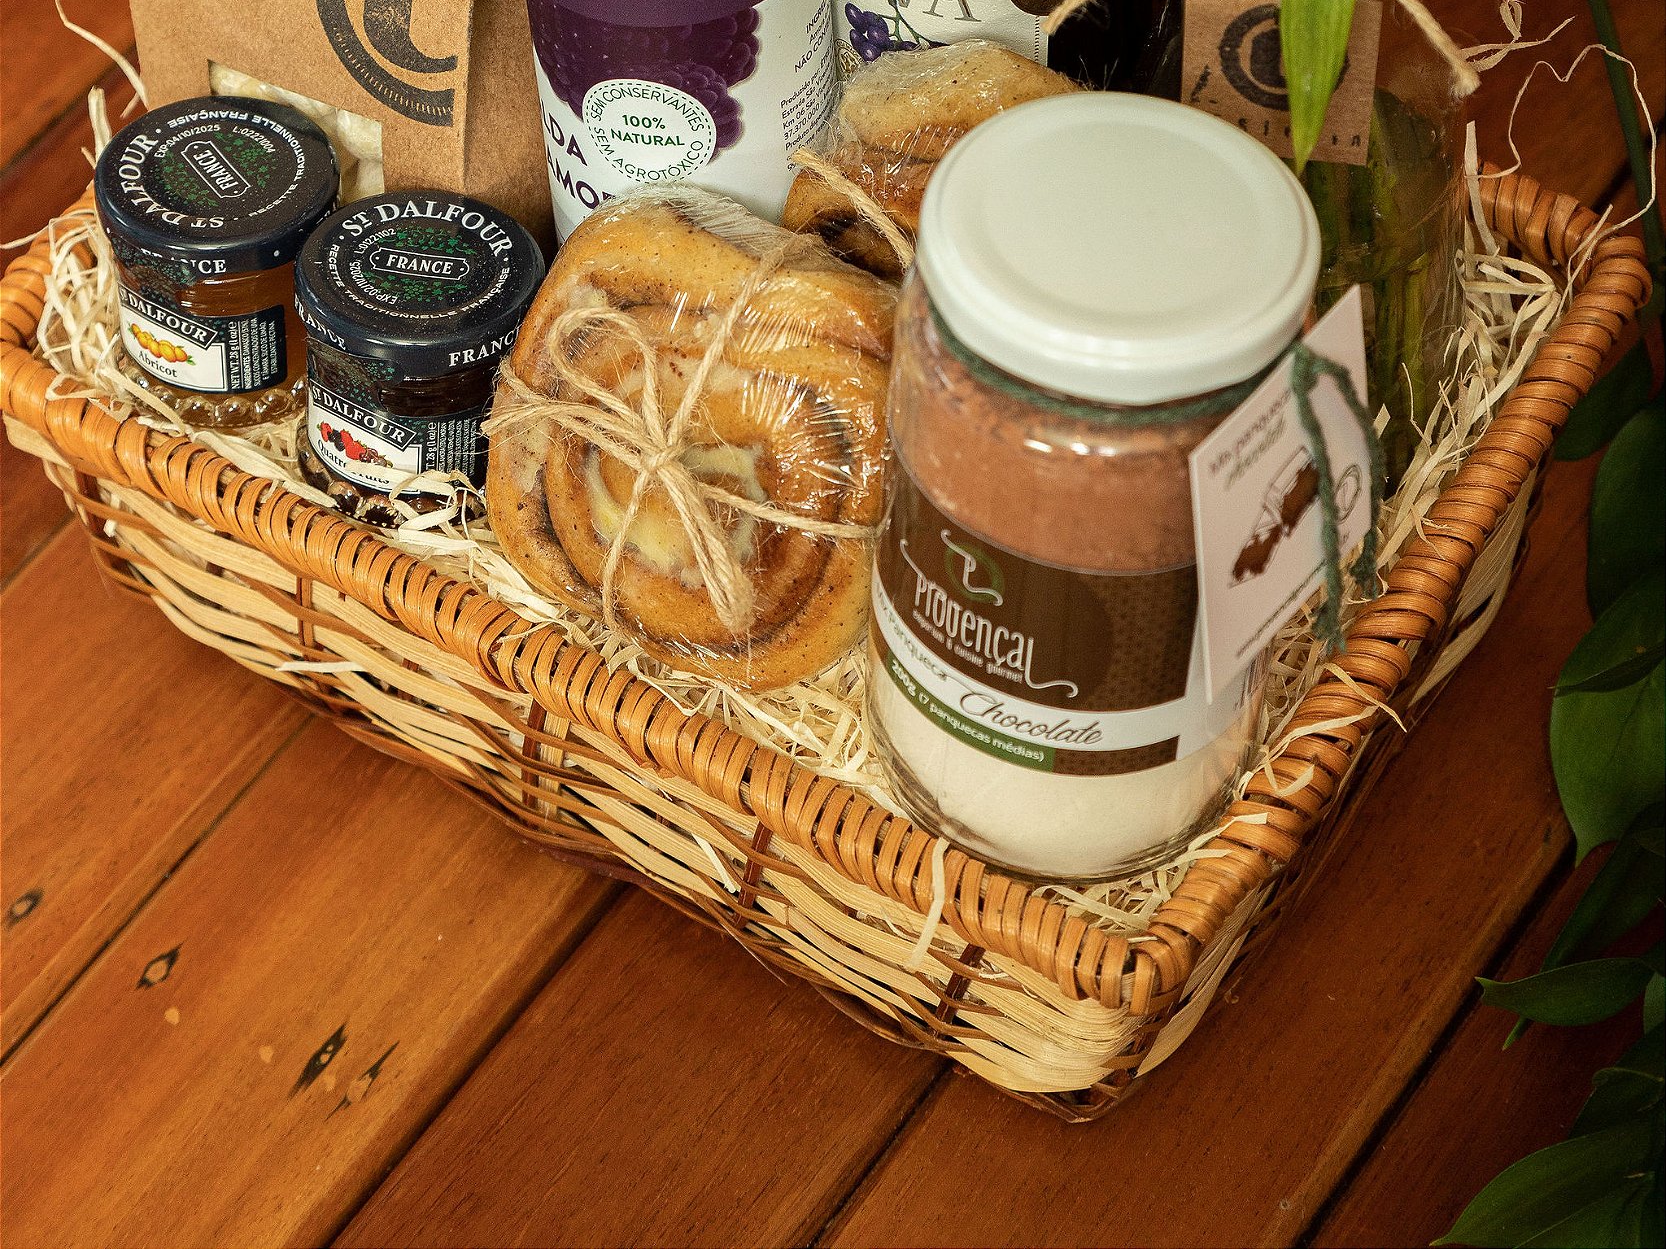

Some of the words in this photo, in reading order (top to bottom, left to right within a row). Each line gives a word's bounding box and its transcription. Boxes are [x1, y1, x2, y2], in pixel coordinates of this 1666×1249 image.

[794, 50, 813, 73] NÃO
[166, 109, 250, 129] FRANÇAISE
[590, 98, 607, 122] SEM
[602, 87, 705, 132] CONSERVANTES
[622, 114, 666, 130] 100%
[251, 113, 306, 181] TRADITIONNELLE
[593, 126, 615, 156] SEM
[613, 140, 704, 181] AGROTÓXICO
[610, 128, 686, 146] NATURAL
[118, 133, 188, 226] DALFOUR
[193, 149, 239, 191] FRANCE
[374, 199, 514, 257] DALFOUR
[327, 243, 345, 288] RECETTE
[343, 289, 458, 320] TRADITIONNELLE
[462, 266, 511, 312] FRANÇAISE
[385, 253, 454, 275] FRANCE
[129, 292, 208, 344] DALFOUR
[138, 350, 178, 379] Abricot
[449, 325, 520, 367] FRANC
[322, 390, 406, 443] DALFOUR
[959, 691, 1104, 745] Chocolate
